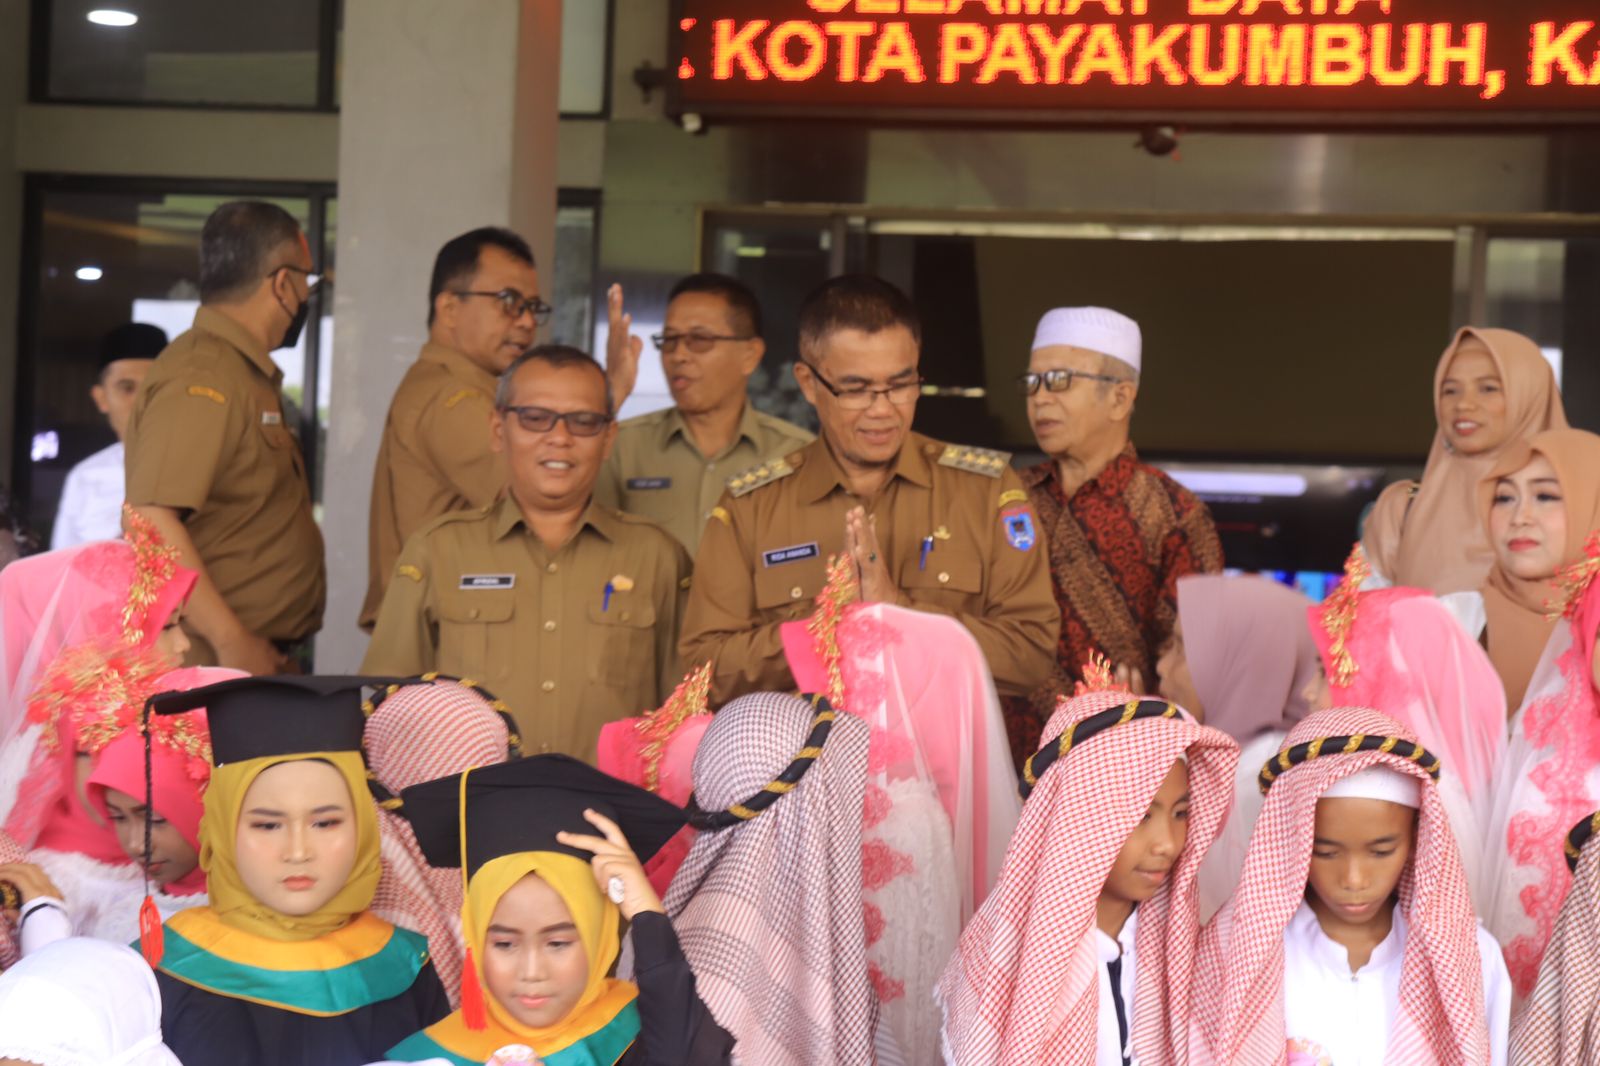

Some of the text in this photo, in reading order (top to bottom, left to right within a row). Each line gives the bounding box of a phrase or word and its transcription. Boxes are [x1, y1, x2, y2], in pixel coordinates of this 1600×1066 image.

[712, 19, 927, 83] KOTA
[938, 22, 1506, 99] PAYAKUMBUH,
[1526, 21, 1600, 86] K
